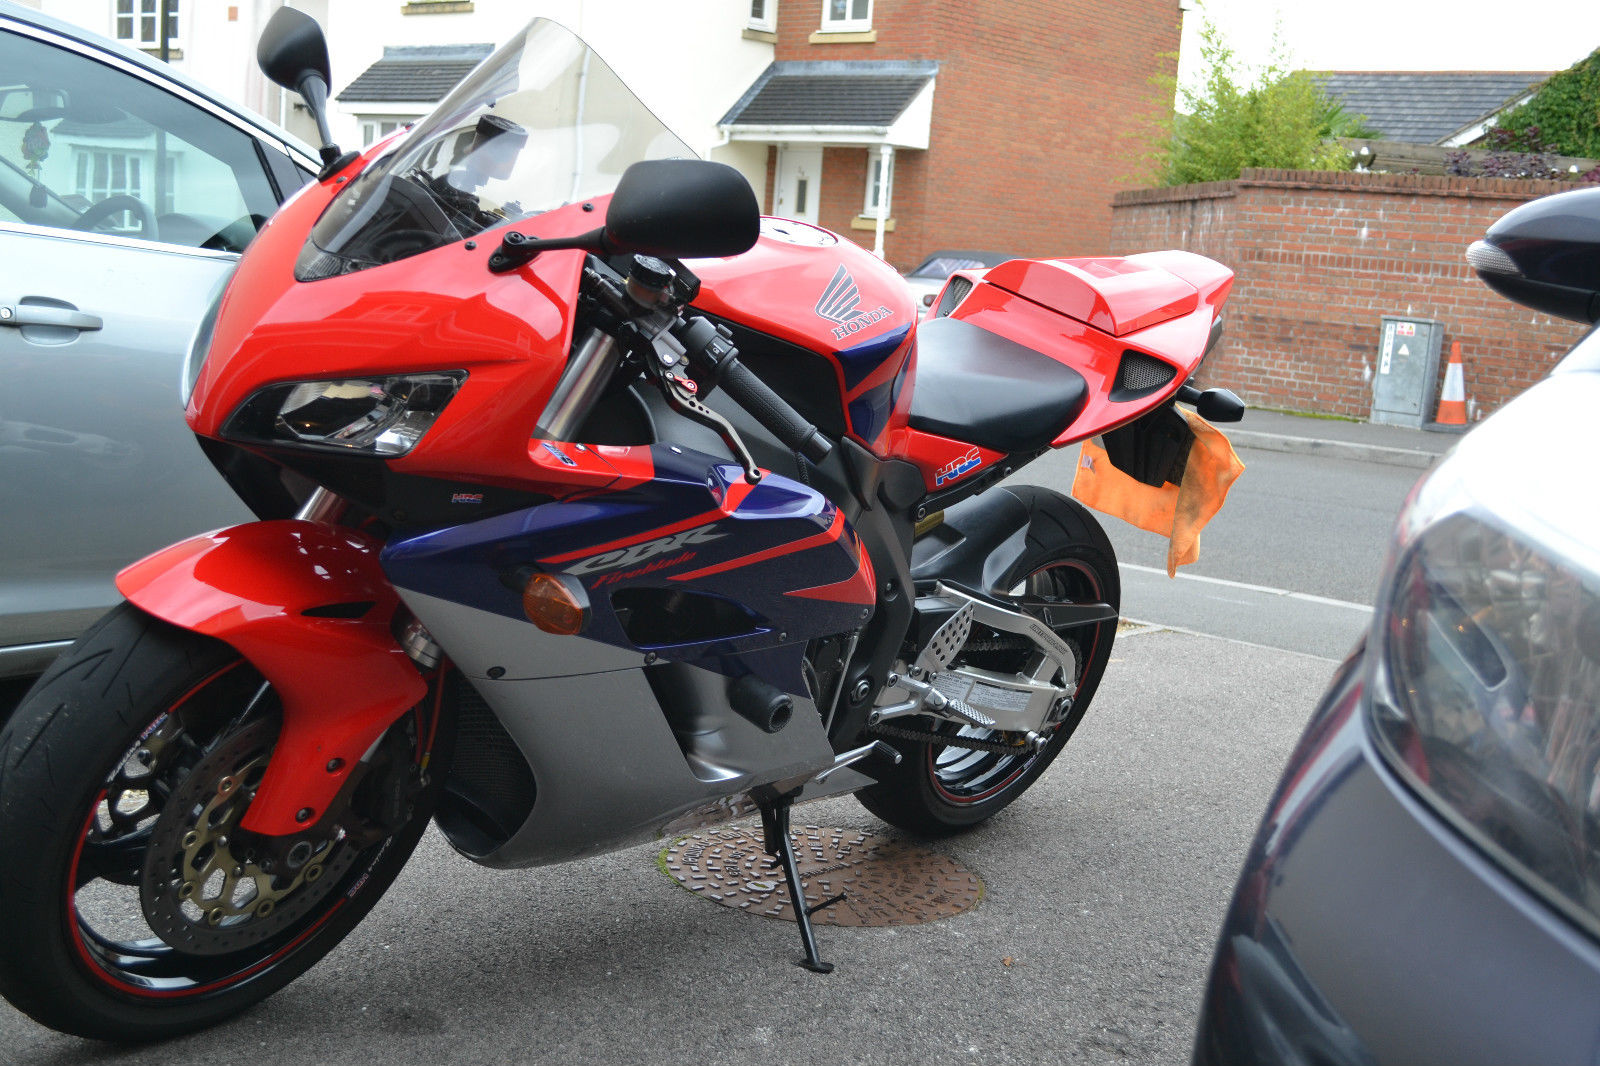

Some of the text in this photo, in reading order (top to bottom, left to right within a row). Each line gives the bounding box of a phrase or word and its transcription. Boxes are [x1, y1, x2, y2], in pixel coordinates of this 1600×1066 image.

[831, 305, 894, 341] HONDA
[935, 446, 982, 487] HRC
[561, 523, 730, 576] CBR
[591, 551, 697, 590] Fireblade
